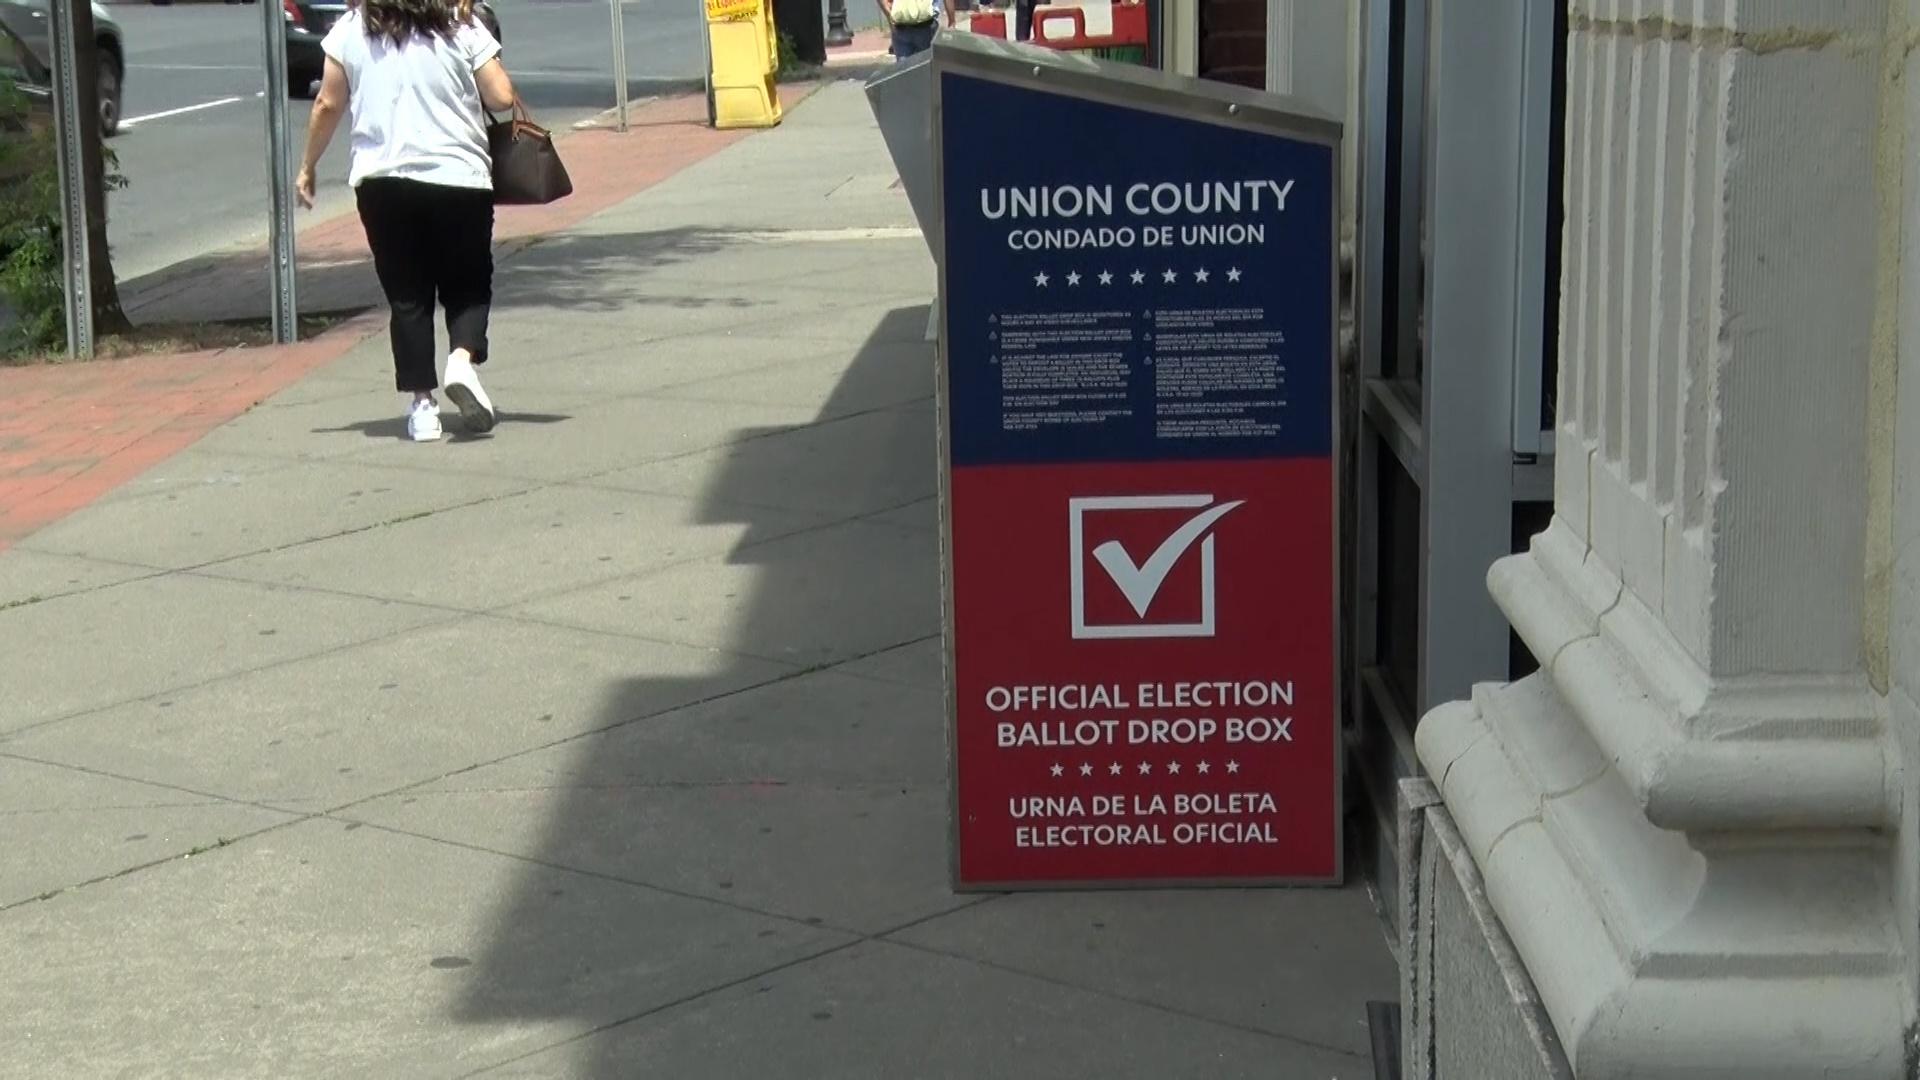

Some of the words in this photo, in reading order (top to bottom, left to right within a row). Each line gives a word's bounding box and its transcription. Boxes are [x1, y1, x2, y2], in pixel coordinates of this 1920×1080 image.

[981, 185, 1113, 219] UNION
[1125, 180, 1295, 215] COUNTY
[1007, 227, 1136, 250] CONDADO
[1143, 226, 1174, 246] DE
[1181, 224, 1265, 246] UNION
[985, 684, 1130, 712] OFFICIAL
[1138, 681, 1293, 708] ELECTION
[997, 720, 1120, 747] BALLOT
[1128, 718, 1217, 744] DROP
[1225, 717, 1293, 742] BOX
[1009, 797, 1086, 818] URNA
[1092, 796, 1126, 816] DE
[1134, 795, 1167, 815] LA
[1174, 793, 1278, 815] BOLETA
[1016, 825, 1167, 847] ELECTORAL
[1172, 822, 1279, 844] OFICIAL
